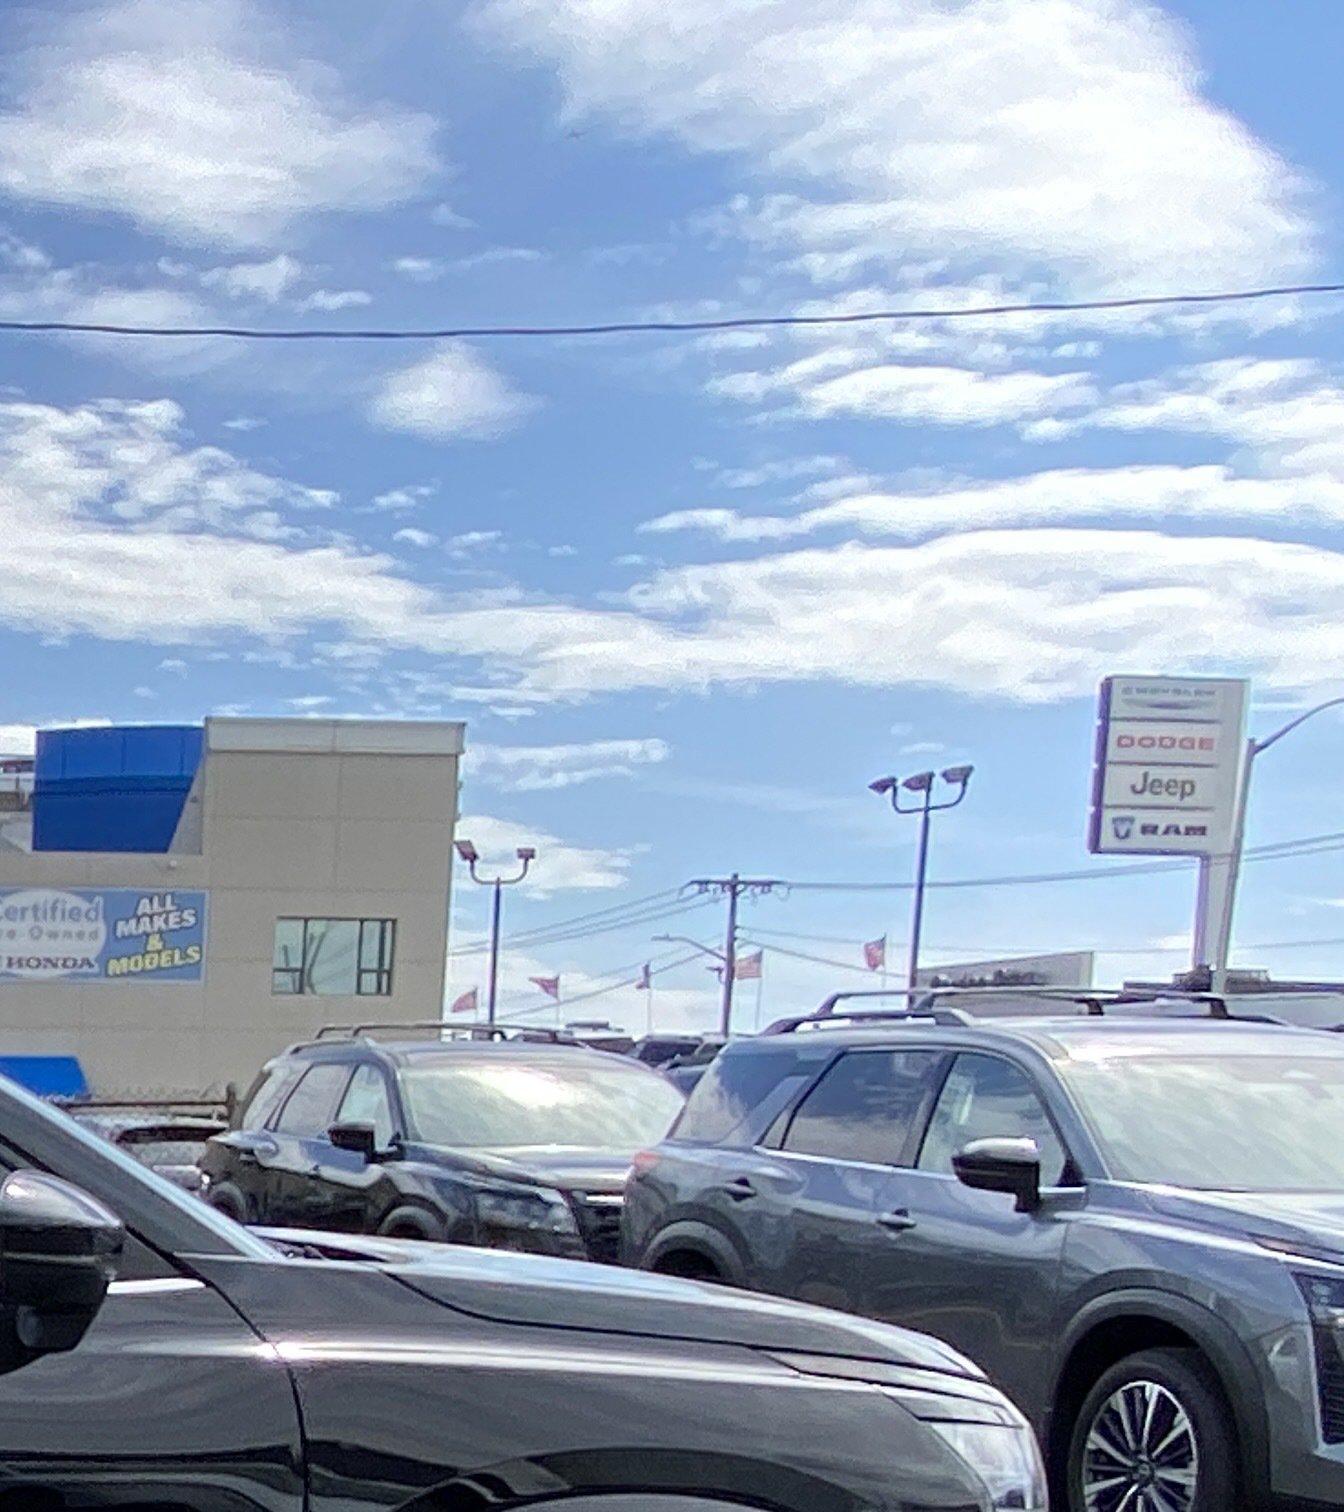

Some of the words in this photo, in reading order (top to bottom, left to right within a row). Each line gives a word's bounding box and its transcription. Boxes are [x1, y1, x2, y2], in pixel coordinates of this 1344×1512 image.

[1116, 735, 1215, 750] DODGE
[1130, 771, 1196, 801] Jeep
[1140, 823, 1207, 836] RAM
[136, 894, 177, 916] ALL
[115, 909, 196, 938] MAKES
[145, 933, 164, 951] &
[6, 956, 95, 970] HONDA
[107, 945, 201, 976] MODELS
